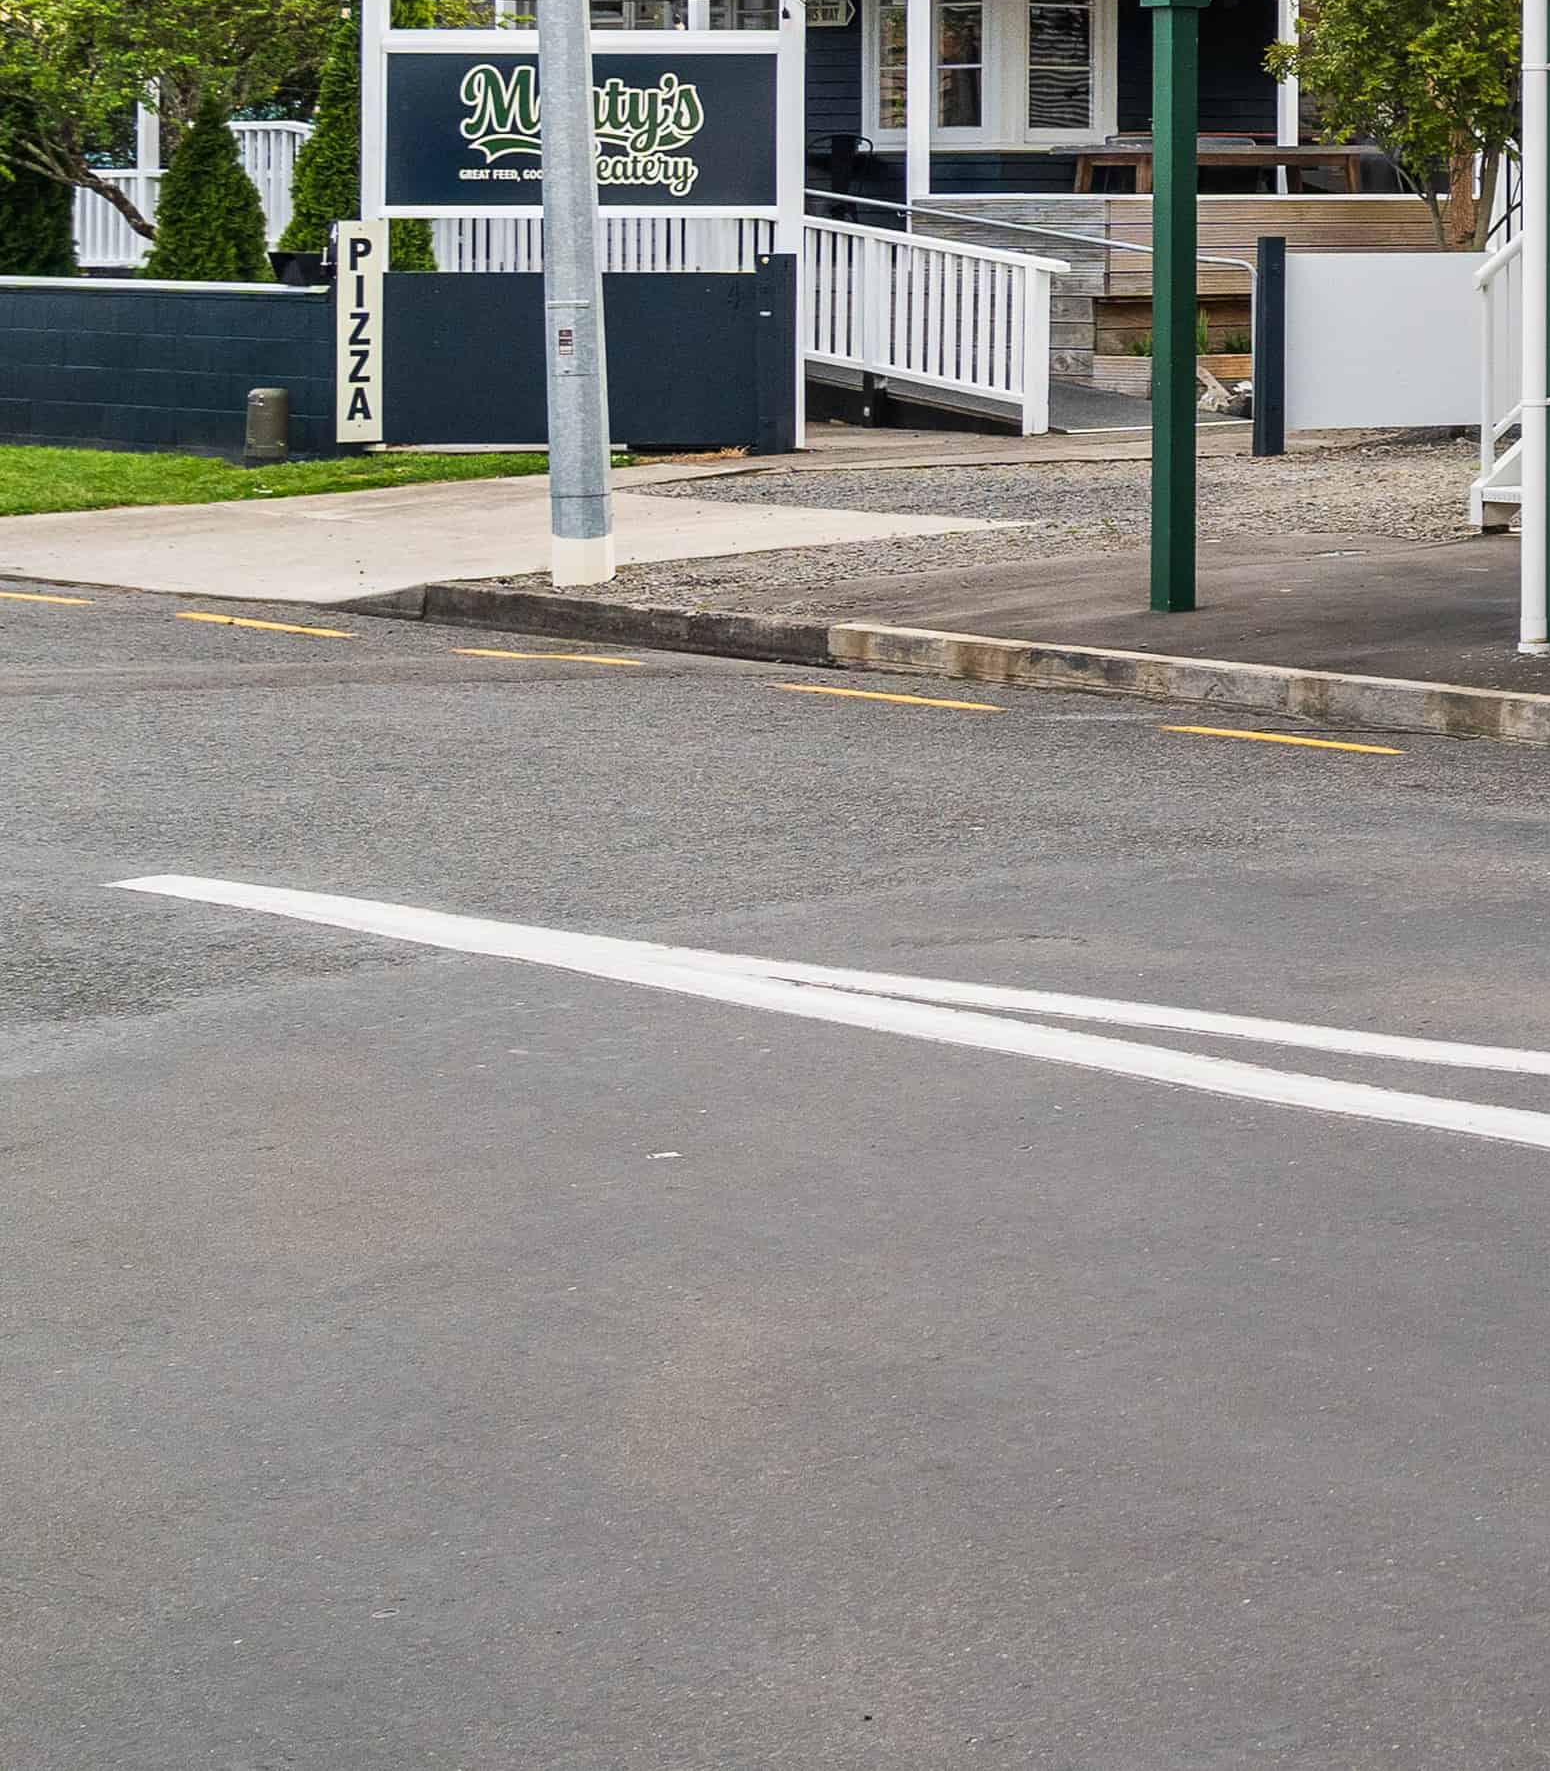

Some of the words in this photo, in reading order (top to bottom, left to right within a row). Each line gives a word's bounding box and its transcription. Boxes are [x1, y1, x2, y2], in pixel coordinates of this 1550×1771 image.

[460, 64, 704, 155] Mty's
[459, 169, 491, 180] GREAT
[597, 153, 699, 197] eatery
[346, 237, 373, 421] PIZZA
